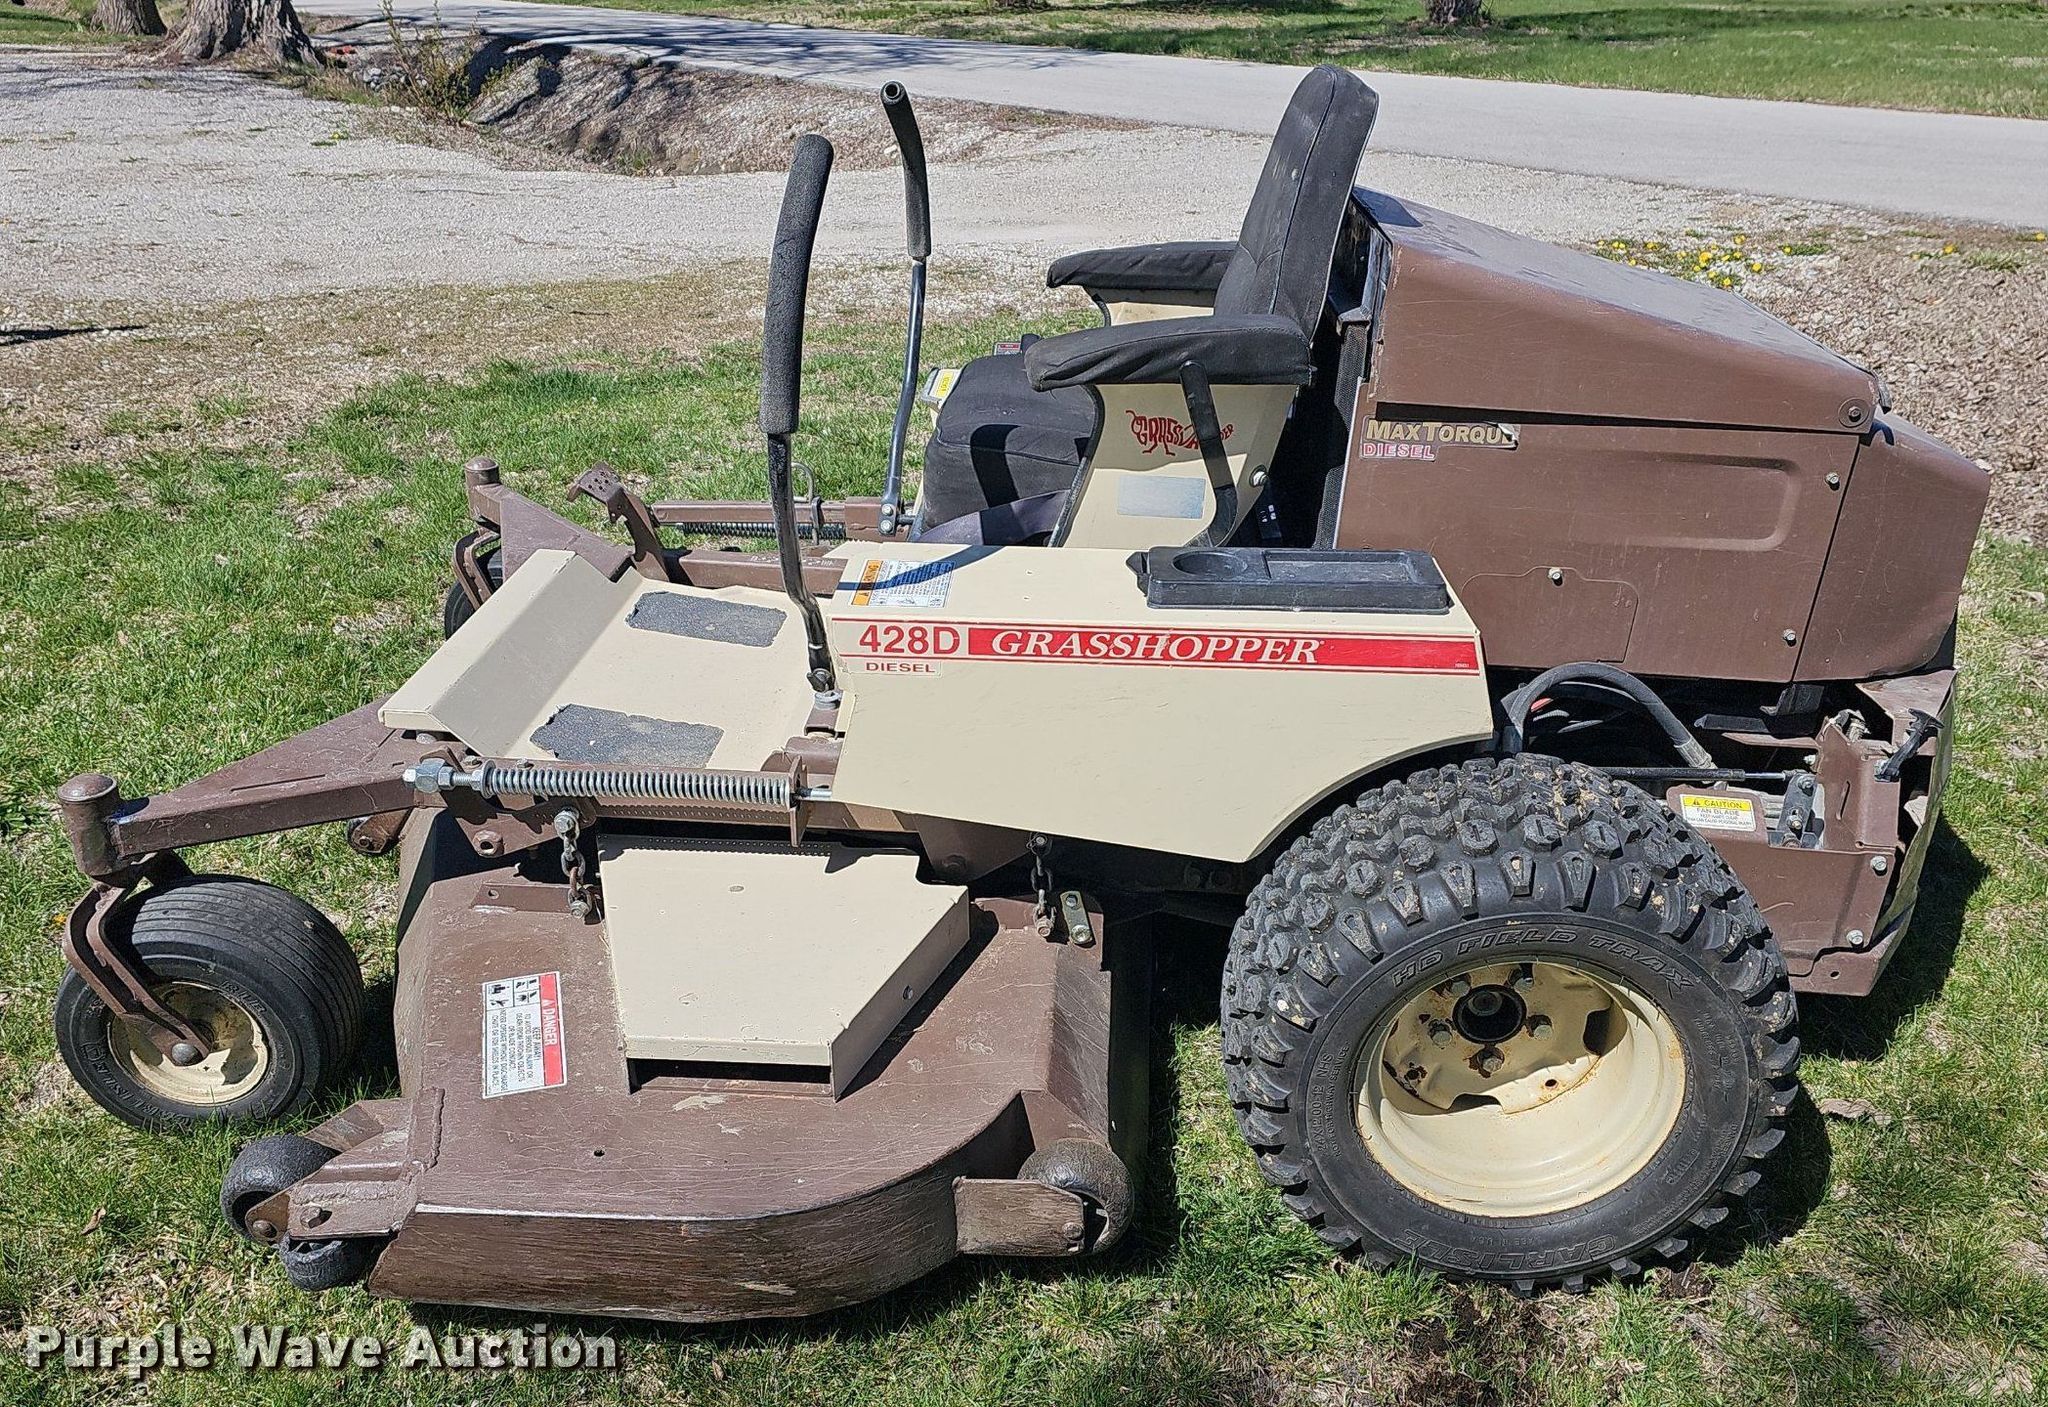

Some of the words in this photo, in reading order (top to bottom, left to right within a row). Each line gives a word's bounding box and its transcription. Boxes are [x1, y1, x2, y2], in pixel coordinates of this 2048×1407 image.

[1366, 419, 1420, 441] MAX
[1421, 421, 1513, 445] TORQU
[1362, 443, 1435, 459] DIESEL
[858, 624, 961, 656] 428D
[990, 629, 1321, 663] GRASSHOPPER
[865, 661, 937, 674] DIESEL
[1703, 799, 1742, 808] CAUTION
[1392, 951, 1443, 987] HD
[1457, 928, 1577, 954] FIELD
[1590, 935, 1696, 991] TRAX
[542, 1007, 557, 1046] DANGER
[1315, 1052, 1333, 1077] NHS
[1392, 1227, 1615, 1269] CARLISLE
